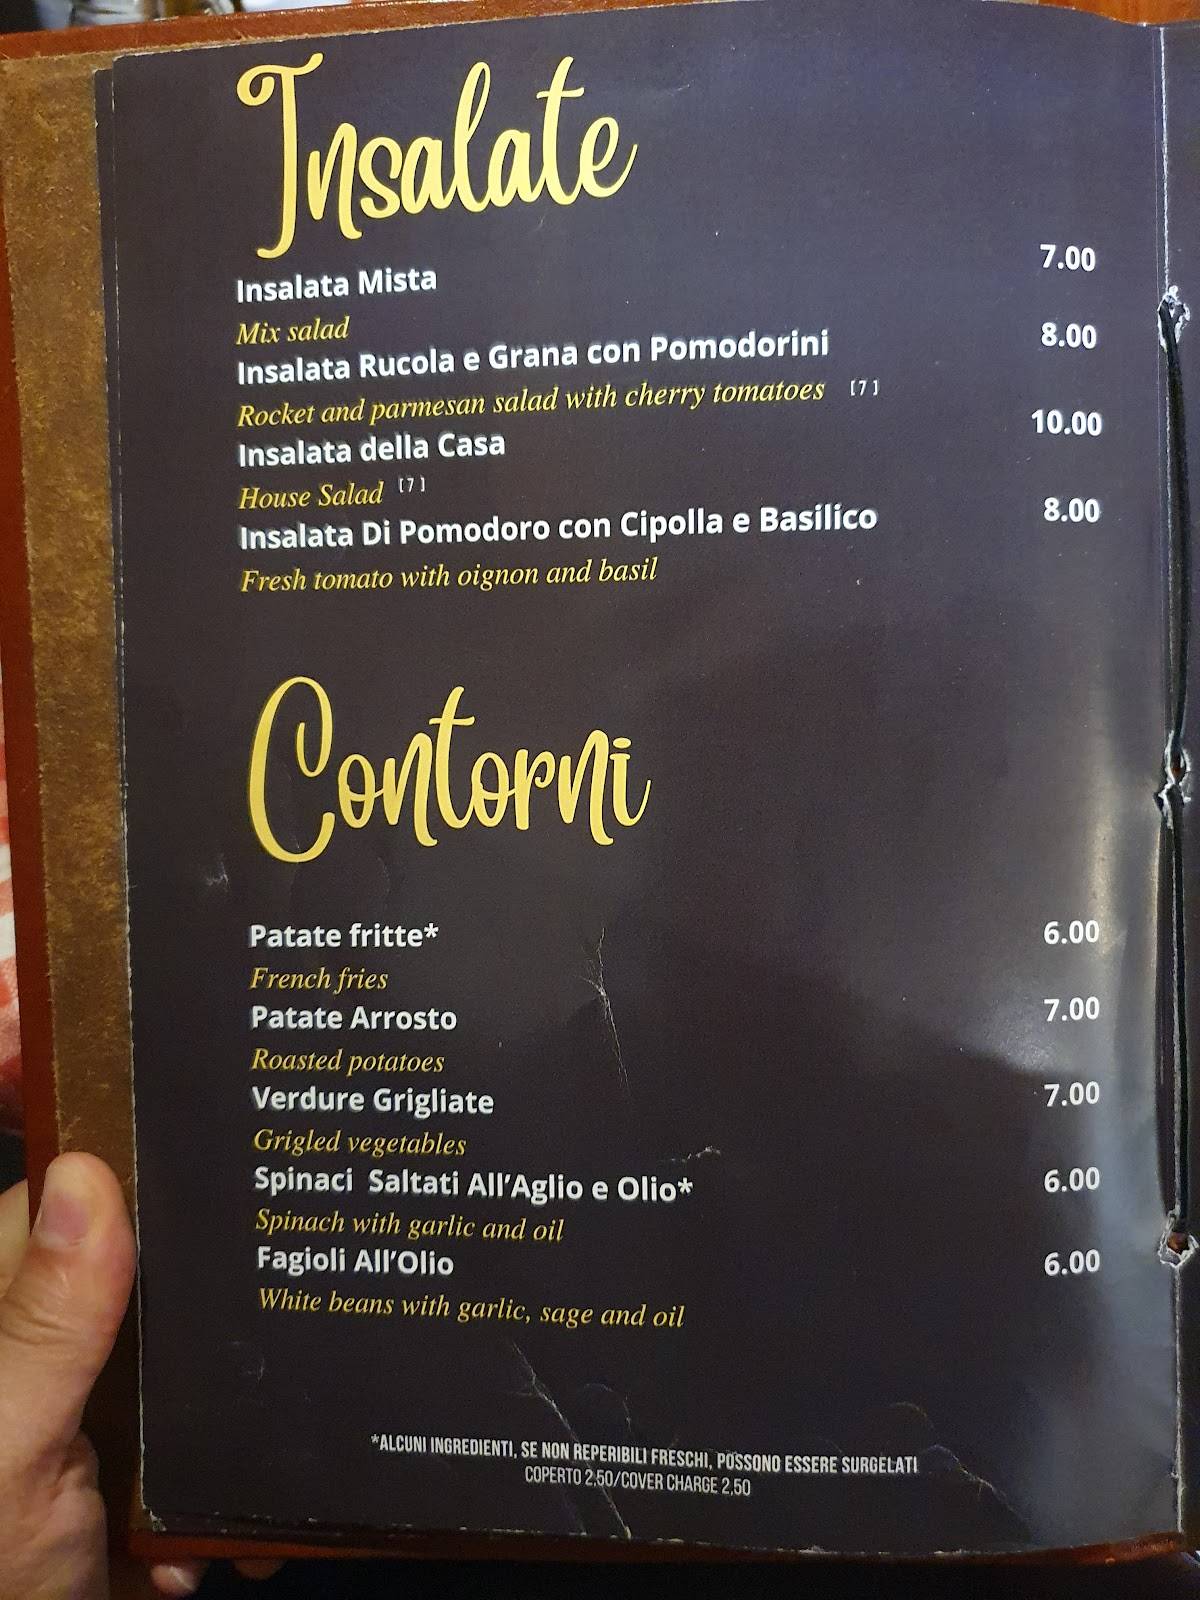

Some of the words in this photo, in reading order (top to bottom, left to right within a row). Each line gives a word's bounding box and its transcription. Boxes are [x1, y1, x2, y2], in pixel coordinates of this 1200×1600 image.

[237, 53, 637, 258] Insalate
[1040, 244, 1095, 271] 7.00
[238, 274, 348, 303] Insalata
[359, 268, 436, 294] Mista
[236, 323, 280, 344] Mix
[288, 316, 349, 341] salad
[1042, 322, 1096, 348] 8.00
[239, 357, 350, 384] Insalata
[360, 348, 454, 377] Rucola
[464, 352, 479, 371] e
[489, 345, 577, 369] Grana
[588, 342, 640, 364] con
[651, 329, 828, 361] Pomodorini
[238, 403, 315, 426] Rocket
[322, 399, 365, 422] and
[370, 398, 485, 425] parmesan
[494, 387, 558, 412] salad
[566, 384, 616, 408] with
[625, 382, 705, 409] cherry
[714, 382, 824, 402] tomatoes
[1032, 410, 1102, 436] 10.00
[240, 440, 351, 467] Insalata
[361, 434, 428, 461] della
[439, 433, 505, 457] Casa
[239, 488, 310, 509] House
[319, 481, 384, 506] Salad
[1044, 497, 1100, 522] 8.00
[241, 523, 353, 549] Insalata
[363, 520, 390, 545] Di
[401, 516, 550, 544] Pomodoro
[559, 518, 610, 539] con
[621, 508, 722, 543] Cipolla
[733, 513, 750, 533] e
[761, 504, 877, 532] Basilico
[242, 569, 306, 591] Fresh
[315, 569, 392, 589] tomato
[402, 564, 449, 587] with
[458, 564, 538, 591] oignon
[547, 560, 592, 583] and
[599, 557, 657, 581] basil
[250, 677, 651, 862] Contorni
[251, 925, 341, 947] Patate
[1044, 919, 1099, 944] 6.00
[251, 967, 331, 988] French
[333, 967, 388, 994] fries
[253, 1006, 342, 1029] Patate
[350, 1006, 456, 1029] Arrosto
[1044, 997, 1099, 1021] 7.00
[252, 1048, 342, 1070] Roasted
[347, 1054, 444, 1076] potatoes
[252, 1086, 364, 1111] Verdure
[374, 1088, 493, 1119] Grigliate
[1045, 1081, 1099, 1106] 7.00
[255, 1129, 341, 1155] Grigled
[349, 1132, 466, 1157] vegetables
[256, 1167, 352, 1195] Spinaci
[370, 1169, 458, 1194] Saltati
[592, 1181, 608, 1200] e
[1045, 1167, 1100, 1192] 6.00
[256, 1209, 344, 1235] Spinach
[354, 1212, 400, 1233] with
[408, 1215, 475, 1239] garlic
[483, 1218, 526, 1239] and
[534, 1219, 564, 1241] oil
[258, 1246, 345, 1276] Fagioli
[1045, 1249, 1100, 1276] 6.00
[261, 1288, 321, 1311] White
[329, 1291, 394, 1313] beans
[403, 1295, 449, 1316] with
[458, 1298, 530, 1323] garlic,
[540, 1308, 593, 1328] sage
[601, 1304, 646, 1325] and
[653, 1306, 684, 1327] oil
[431, 1437, 517, 1458] INGREDIENTI,
[521, 1441, 537, 1458] SE
[542, 1442, 569, 1459] NON
[574, 1443, 647, 1464] REPERIBILI
[652, 1449, 712, 1470] FRESCHI,
[718, 1452, 780, 1472] POSSONO
[785, 1456, 837, 1473] ESSERE
[842, 1457, 917, 1474] SURGELATI
[525, 1466, 581, 1485] COPERTO
[667, 1474, 717, 1493] CHARGE
